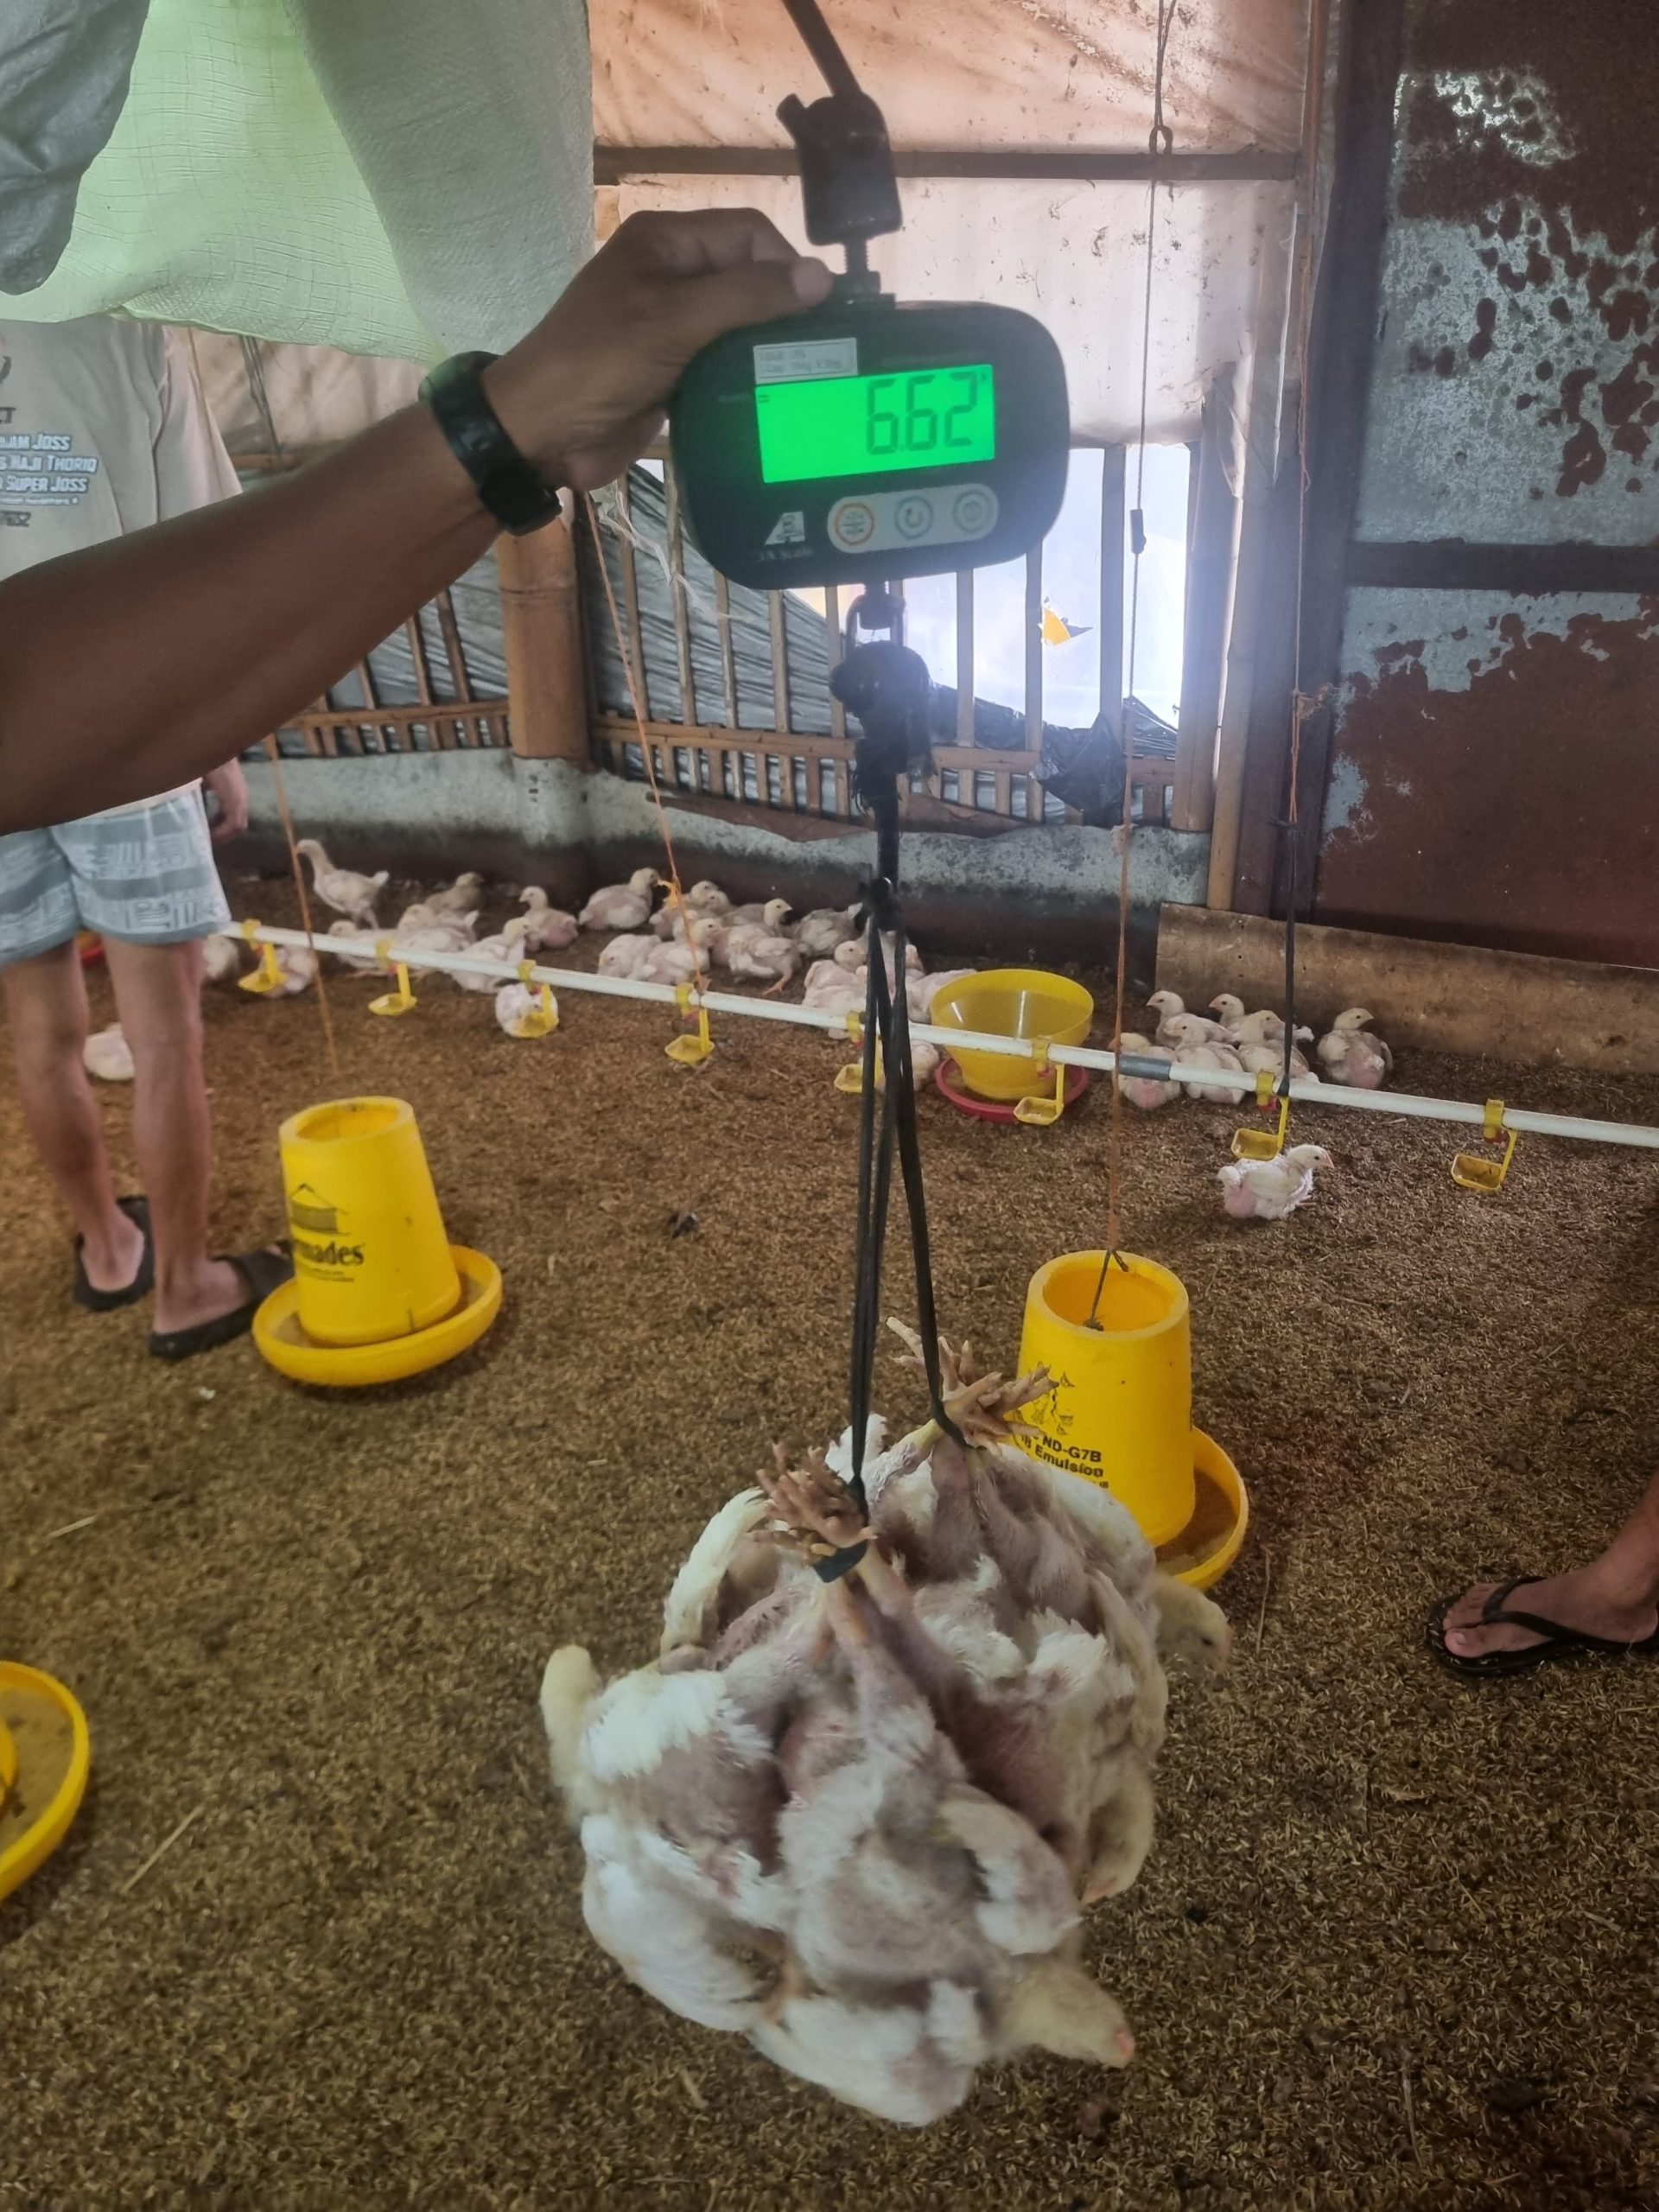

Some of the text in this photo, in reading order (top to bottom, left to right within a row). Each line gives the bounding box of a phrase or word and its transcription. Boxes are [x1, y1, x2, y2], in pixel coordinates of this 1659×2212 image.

[32, 433, 71, 450] JOSS
[50, 476, 88, 493] JOSS
[1042, 1435, 1103, 1463] ND-G7B
[1035, 1445, 1104, 1478] Emulsion
